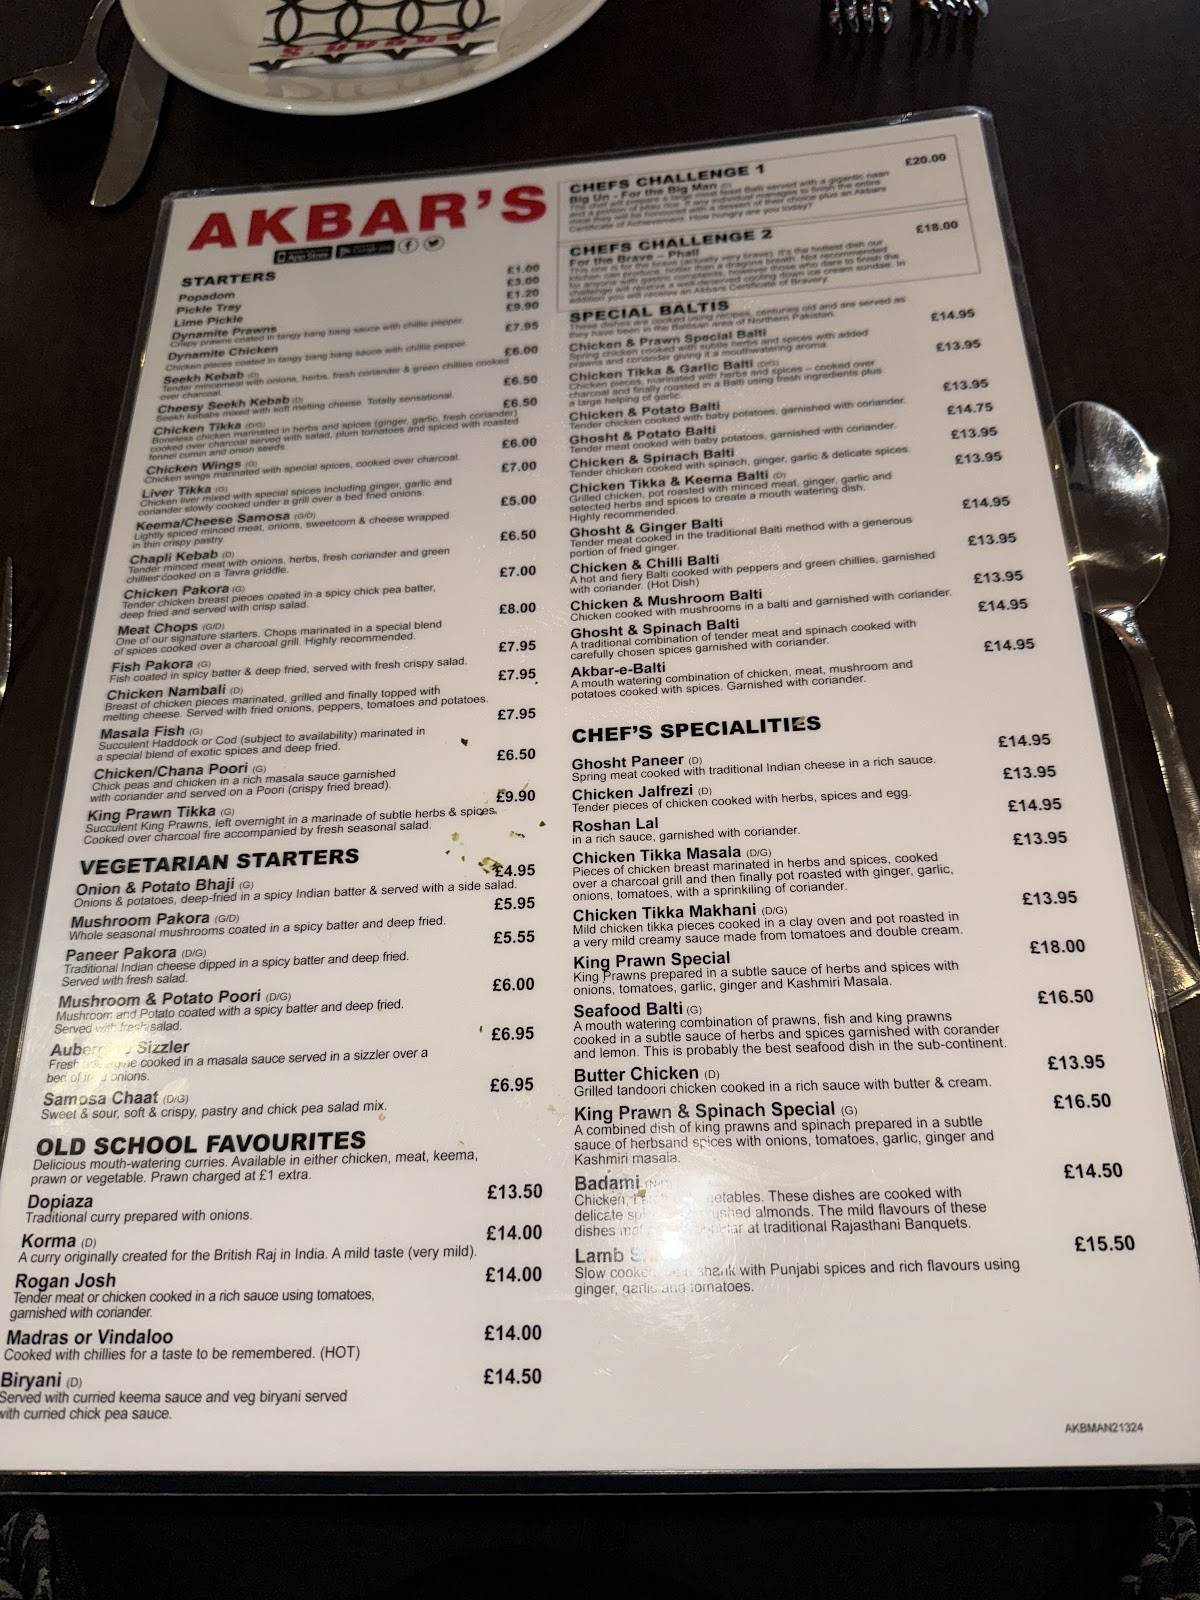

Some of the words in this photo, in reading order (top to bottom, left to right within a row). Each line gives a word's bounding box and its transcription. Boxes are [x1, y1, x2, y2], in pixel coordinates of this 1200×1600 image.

[905, 152, 947, 166] £20.00
[569, 178, 630, 194] CHEFS
[635, 165, 749, 187] CHALLENGE
[755, 163, 764, 174] 1
[188, 184, 548, 251] AKBAR'S
[915, 219, 959, 234] £18.00
[569, 241, 632, 257] CHEFS
[638, 229, 755, 251] CHALLENGE
[761, 227, 773, 239] 2
[506, 262, 540, 275] £1.00
[181, 270, 276, 288] STARTERS
[177, 291, 236, 303] Popadom
[175, 304, 213, 315] Pickle
[216, 303, 242, 313] Tray
[569, 306, 653, 323] SPECIAL
[659, 299, 729, 316] BALTIS
[930, 308, 976, 322] £14.95
[173, 318, 204, 328] Lime
[205, 314, 244, 325] Pickle
[504, 320, 539, 332] £7.95
[568, 340, 622, 352] Chicken
[625, 338, 636, 348] &
[639, 336, 681, 347] Prawn
[683, 330, 733, 345] Special
[736, 327, 767, 339] Balti
[167, 348, 226, 363] Dynamite
[228, 345, 279, 356] Chicken
[503, 373, 538, 386] £6.50
[157, 403, 204, 414] Cheesy
[207, 398, 246, 411] Seekh
[248, 395, 290, 407] Kebab
[946, 401, 994, 415] £14.75
[569, 432, 619, 445] Ghosht
[622, 431, 633, 441] &
[636, 428, 681, 440] Potato
[685, 424, 716, 437] Balti
[954, 450, 1003, 465] £13.95
[145, 464, 198, 476] Chicken
[201, 460, 242, 471] Wings
[501, 460, 537, 473] £7.00
[569, 481, 625, 494] Chicken
[629, 477, 666, 489] Tikka
[670, 476, 680, 487] &
[684, 474, 732, 486] Keema
[736, 469, 769, 482] Balti
[141, 488, 175, 499] Liver
[177, 484, 212, 496] Tikka
[500, 494, 536, 507] £5.00
[135, 516, 234, 531] Keema/Cheese
[236, 512, 290, 524] Samosa
[569, 512, 600, 524] Highly
[603, 508, 678, 520] recommended.
[569, 584, 590, 594] with
[593, 582, 643, 593] coriander.
[646, 579, 669, 591] (Hot
[671, 577, 700, 588] Dish)
[499, 602, 536, 615] £8.00
[116, 624, 150, 636] Meat
[153, 622, 198, 634] Chops
[202, 622, 225, 631] (G/D)
[983, 637, 1035, 652] £14.95
[570, 661, 665, 678] Akbar-e-Balti
[571, 724, 653, 744] CHEF'S
[660, 715, 821, 739] SPECIALITIES
[496, 748, 536, 761] £6.50
[571, 757, 627, 770] Ghosht
[631, 755, 684, 767] Paneer
[688, 756, 702, 766] (D)
[93, 765, 204, 780] Chicken/Chana
[208, 761, 248, 775] Poori
[571, 802, 610, 813] Tender
[612, 801, 649, 813] pieces
[651, 798, 663, 809] of
[665, 797, 708, 809] chicken
[711, 795, 752, 806] cooked
[755, 793, 778, 804] with
[781, 792, 817, 803] herbs,
[820, 792, 857, 803] spices
[860, 788, 883, 799] and
[886, 789, 911, 800] egg.
[1007, 797, 1062, 812] £14.95
[87, 809, 121, 824] King
[125, 807, 172, 820] Prawn
[176, 805, 216, 818] Tikka
[572, 819, 631, 832] Roshan
[636, 816, 659, 830] Lal
[80, 854, 229, 875] VEGETARIAN
[236, 848, 359, 869] STARTERS
[1021, 890, 1078, 906] £13.95
[573, 908, 637, 922] Chicken
[641, 905, 684, 919] Tikka
[689, 903, 757, 918] Makhani
[761, 905, 788, 917] (D/G)
[493, 929, 535, 944] £5.55
[65, 949, 119, 962] Paneer
[122, 946, 177, 960] Pakora
[60, 975, 100, 987] Served
[101, 974, 124, 986] with
[125, 973, 154, 985] fresh
[155, 972, 188, 984] salad.
[573, 986, 615, 996] onions,
[619, 983, 676, 994] tomatoes,
[680, 980, 716, 995] garlic,
[719, 981, 757, 993] ginger
[761, 978, 783, 990] and
[787, 976, 840, 989] Kashmiri
[843, 975, 892, 987] Masala.
[58, 994, 140, 1009] Mushroom
[145, 992, 157, 1006] &
[161, 991, 214, 1005] Potato
[218, 990, 261, 1004] Poori
[1037, 989, 1094, 1005] £16.50
[574, 1002, 641, 1018] Seafood
[646, 1001, 683, 1016] Balti
[1047, 1054, 1105, 1070] £13.95
[574, 1068, 626, 1083] Butter
[630, 1065, 699, 1081] Chicken
[489, 1076, 534, 1093] £6.95
[43, 1092, 106, 1106] Samosa
[111, 1090, 159, 1105] Chaat
[574, 1106, 613, 1125] King
[619, 1105, 672, 1120] Prawn
[677, 1103, 690, 1119] &
[695, 1102, 766, 1122] Spinach
[771, 1100, 835, 1120] Special
[36, 1137, 86, 1157] OLD
[93, 1135, 197, 1155] SCHOOL
[206, 1130, 366, 1153] FAVOURITES
[1064, 1162, 1123, 1179] £14.50
[487, 1183, 543, 1200] £13.50
[27, 1194, 93, 1213] Dopiaza
[25, 1210, 88, 1224] Traditional
[90, 1213, 121, 1226] curry
[123, 1209, 178, 1225] prepared
[181, 1209, 206, 1221] with
[209, 1211, 252, 1221] onions.
[21, 1233, 76, 1248] Korma
[81, 1237, 97, 1249] (D)
[486, 1224, 543, 1241] £14.00
[1074, 1235, 1135, 1252] £15.50
[9, 1306, 68, 1323] garnished
[69, 1306, 93, 1318] with
[95, 1305, 152, 1319] coriander.
[6, 1329, 69, 1345] Madras
[74, 1332, 93, 1345] or
[98, 1328, 174, 1345] Vindaloo
[0, 1371, 62, 1392] Biryani
[483, 1368, 542, 1385] £14.50
